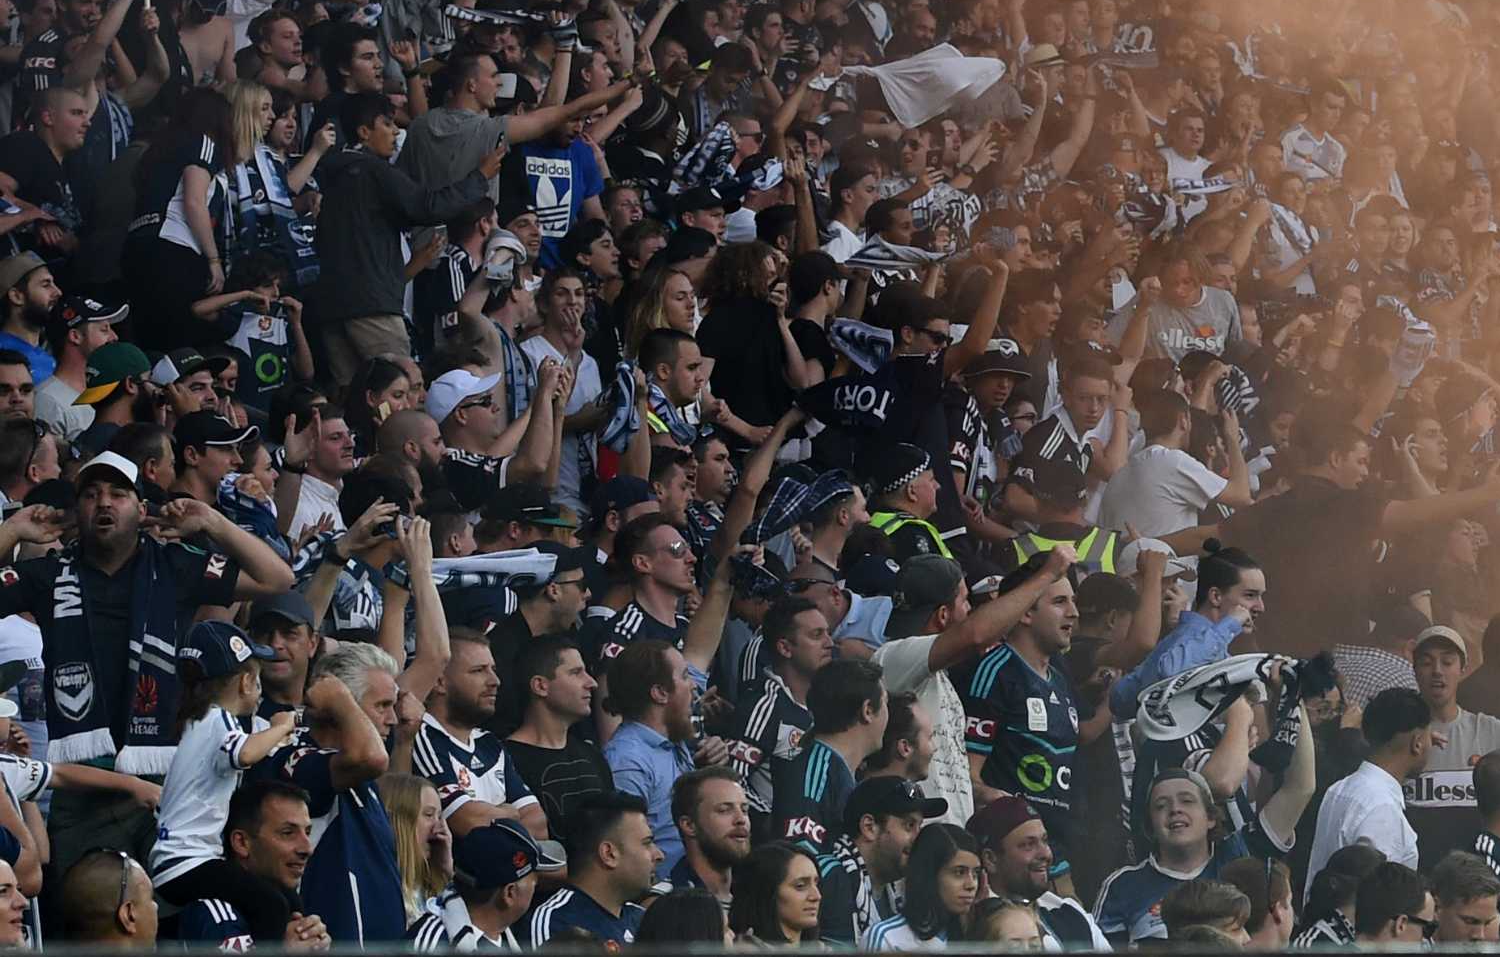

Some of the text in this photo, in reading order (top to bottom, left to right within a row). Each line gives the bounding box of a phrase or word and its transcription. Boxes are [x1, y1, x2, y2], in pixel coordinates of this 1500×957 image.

[25, 57, 56, 70] KFC
[528, 161, 570, 177] adidas
[965, 716, 995, 738] FC
[1406, 777, 1476, 801] elless
[786, 816, 827, 844] KFC
